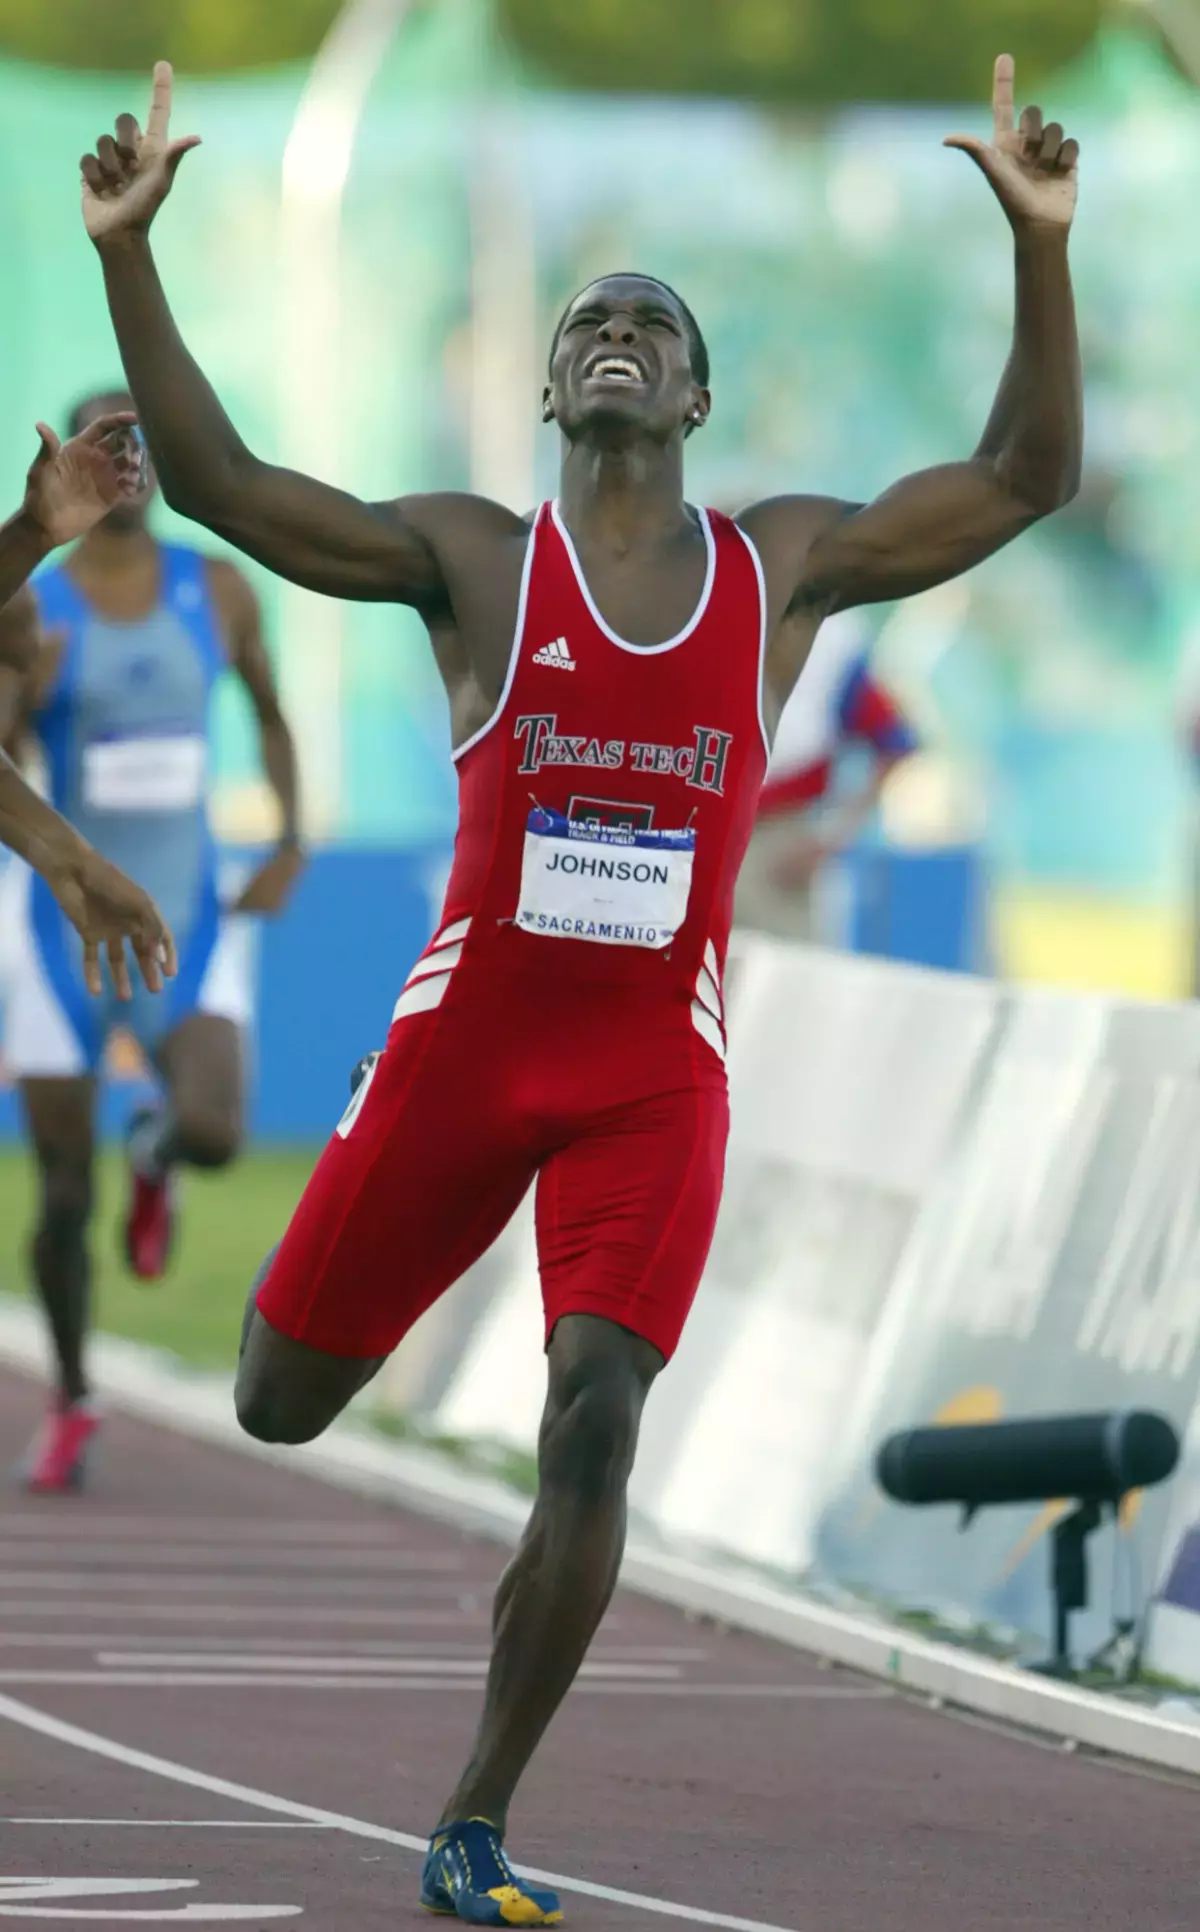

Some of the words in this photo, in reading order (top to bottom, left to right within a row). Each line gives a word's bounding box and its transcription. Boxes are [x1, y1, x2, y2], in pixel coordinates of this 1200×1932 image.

[532, 653, 577, 672] adidas
[514, 713, 625, 775] TEXAS
[629, 725, 733, 797] TECH
[545, 853, 669, 884] JOHNSON
[537, 914, 657, 942] SACRAMENTO
